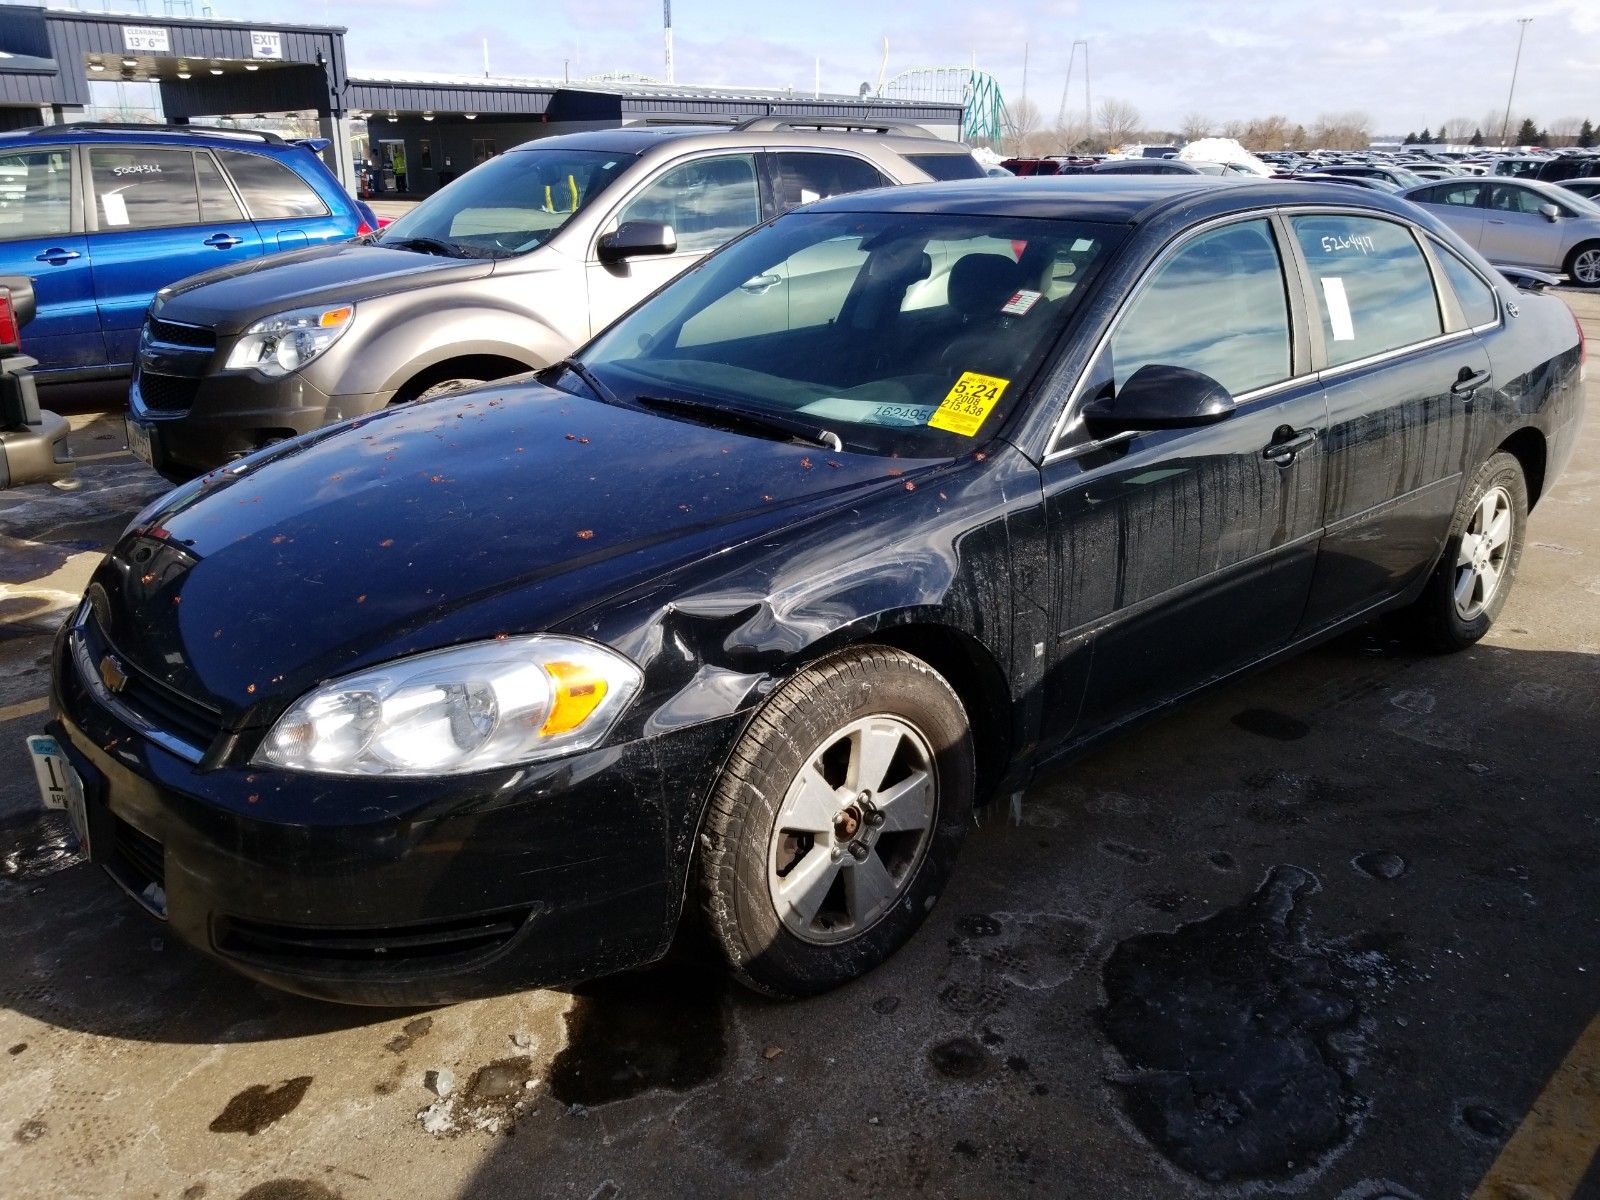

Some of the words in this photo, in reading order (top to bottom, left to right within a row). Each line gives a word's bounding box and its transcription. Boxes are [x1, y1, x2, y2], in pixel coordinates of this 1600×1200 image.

[127, 28, 165, 37] CLEARANCE
[252, 34, 279, 46] EXIT
[955, 393, 981, 406] 2008
